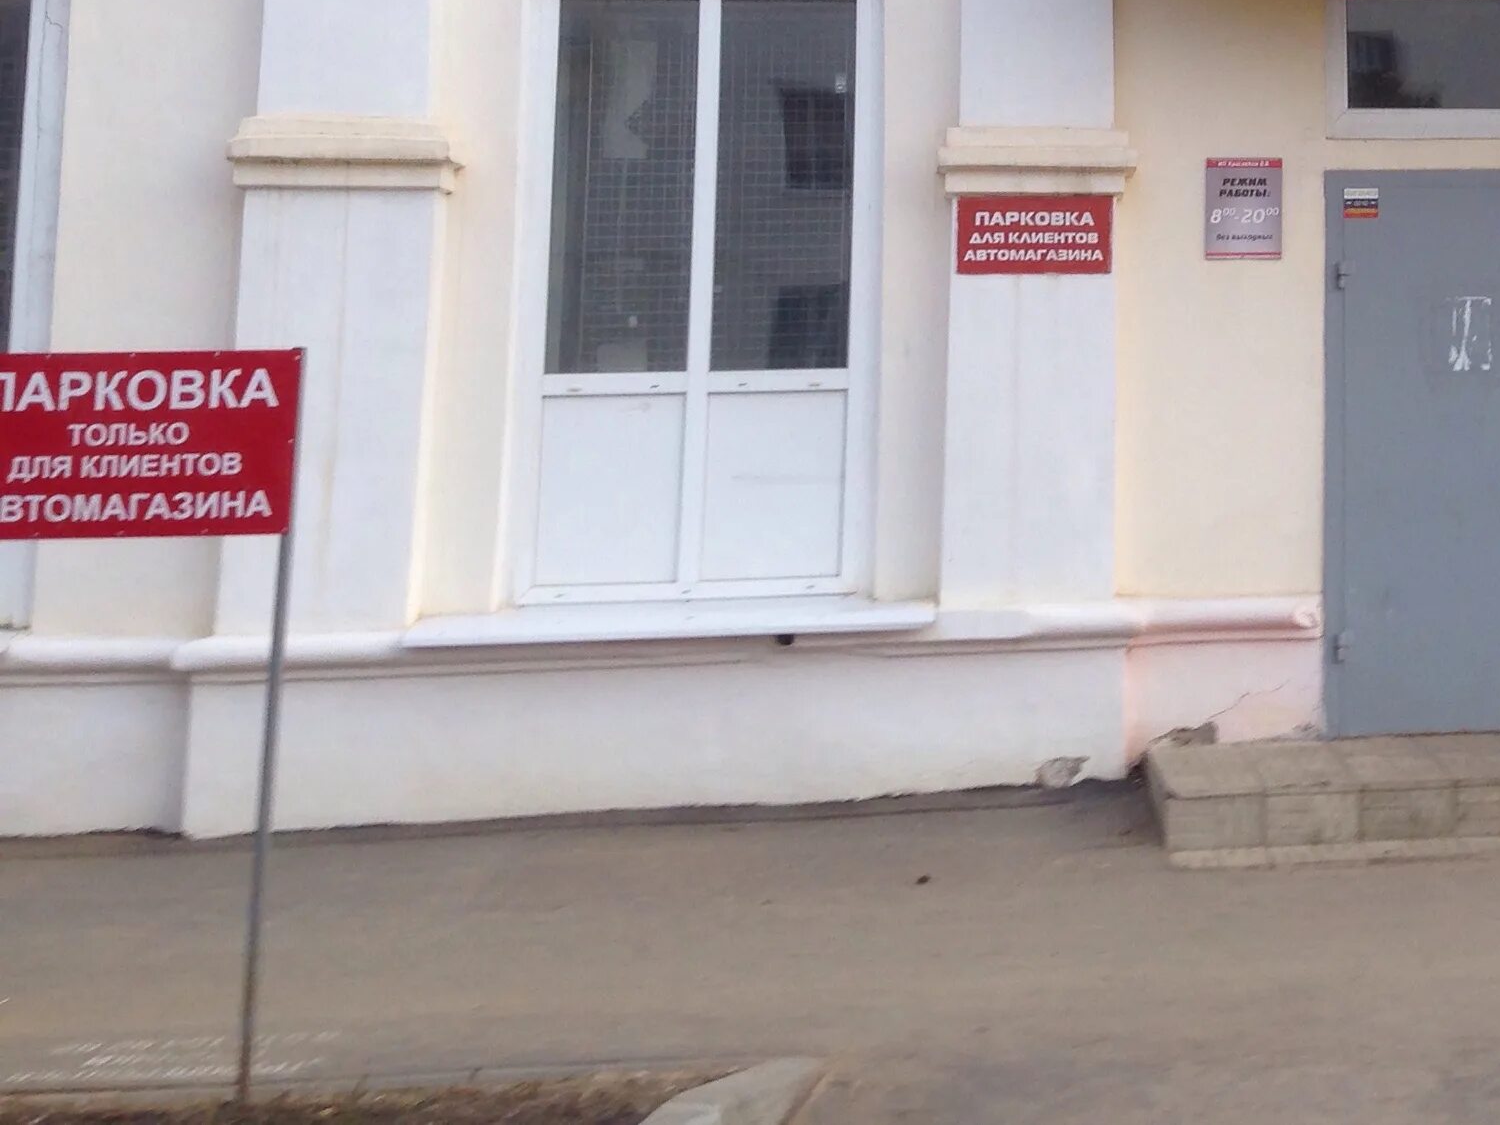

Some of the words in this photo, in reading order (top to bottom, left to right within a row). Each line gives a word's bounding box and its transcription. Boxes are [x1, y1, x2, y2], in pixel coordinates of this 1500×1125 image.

[1222, 178, 1268, 186] РЕЖИМ
[975, 211, 1095, 226] ПАРКОВКА
[969, 232, 1005, 244] ДЛЯ
[1008, 232, 1099, 244] КЛИЕНТОВ
[964, 249, 1104, 262] АВТОМАГАЗИНА
[67, 421, 190, 447] ТОЛЬКО
[5, 455, 73, 484] ДЛЯ
[80, 452, 243, 478] КЛИЕНТОВ
[0, 489, 273, 522] ВТОМАГАЗИНА
